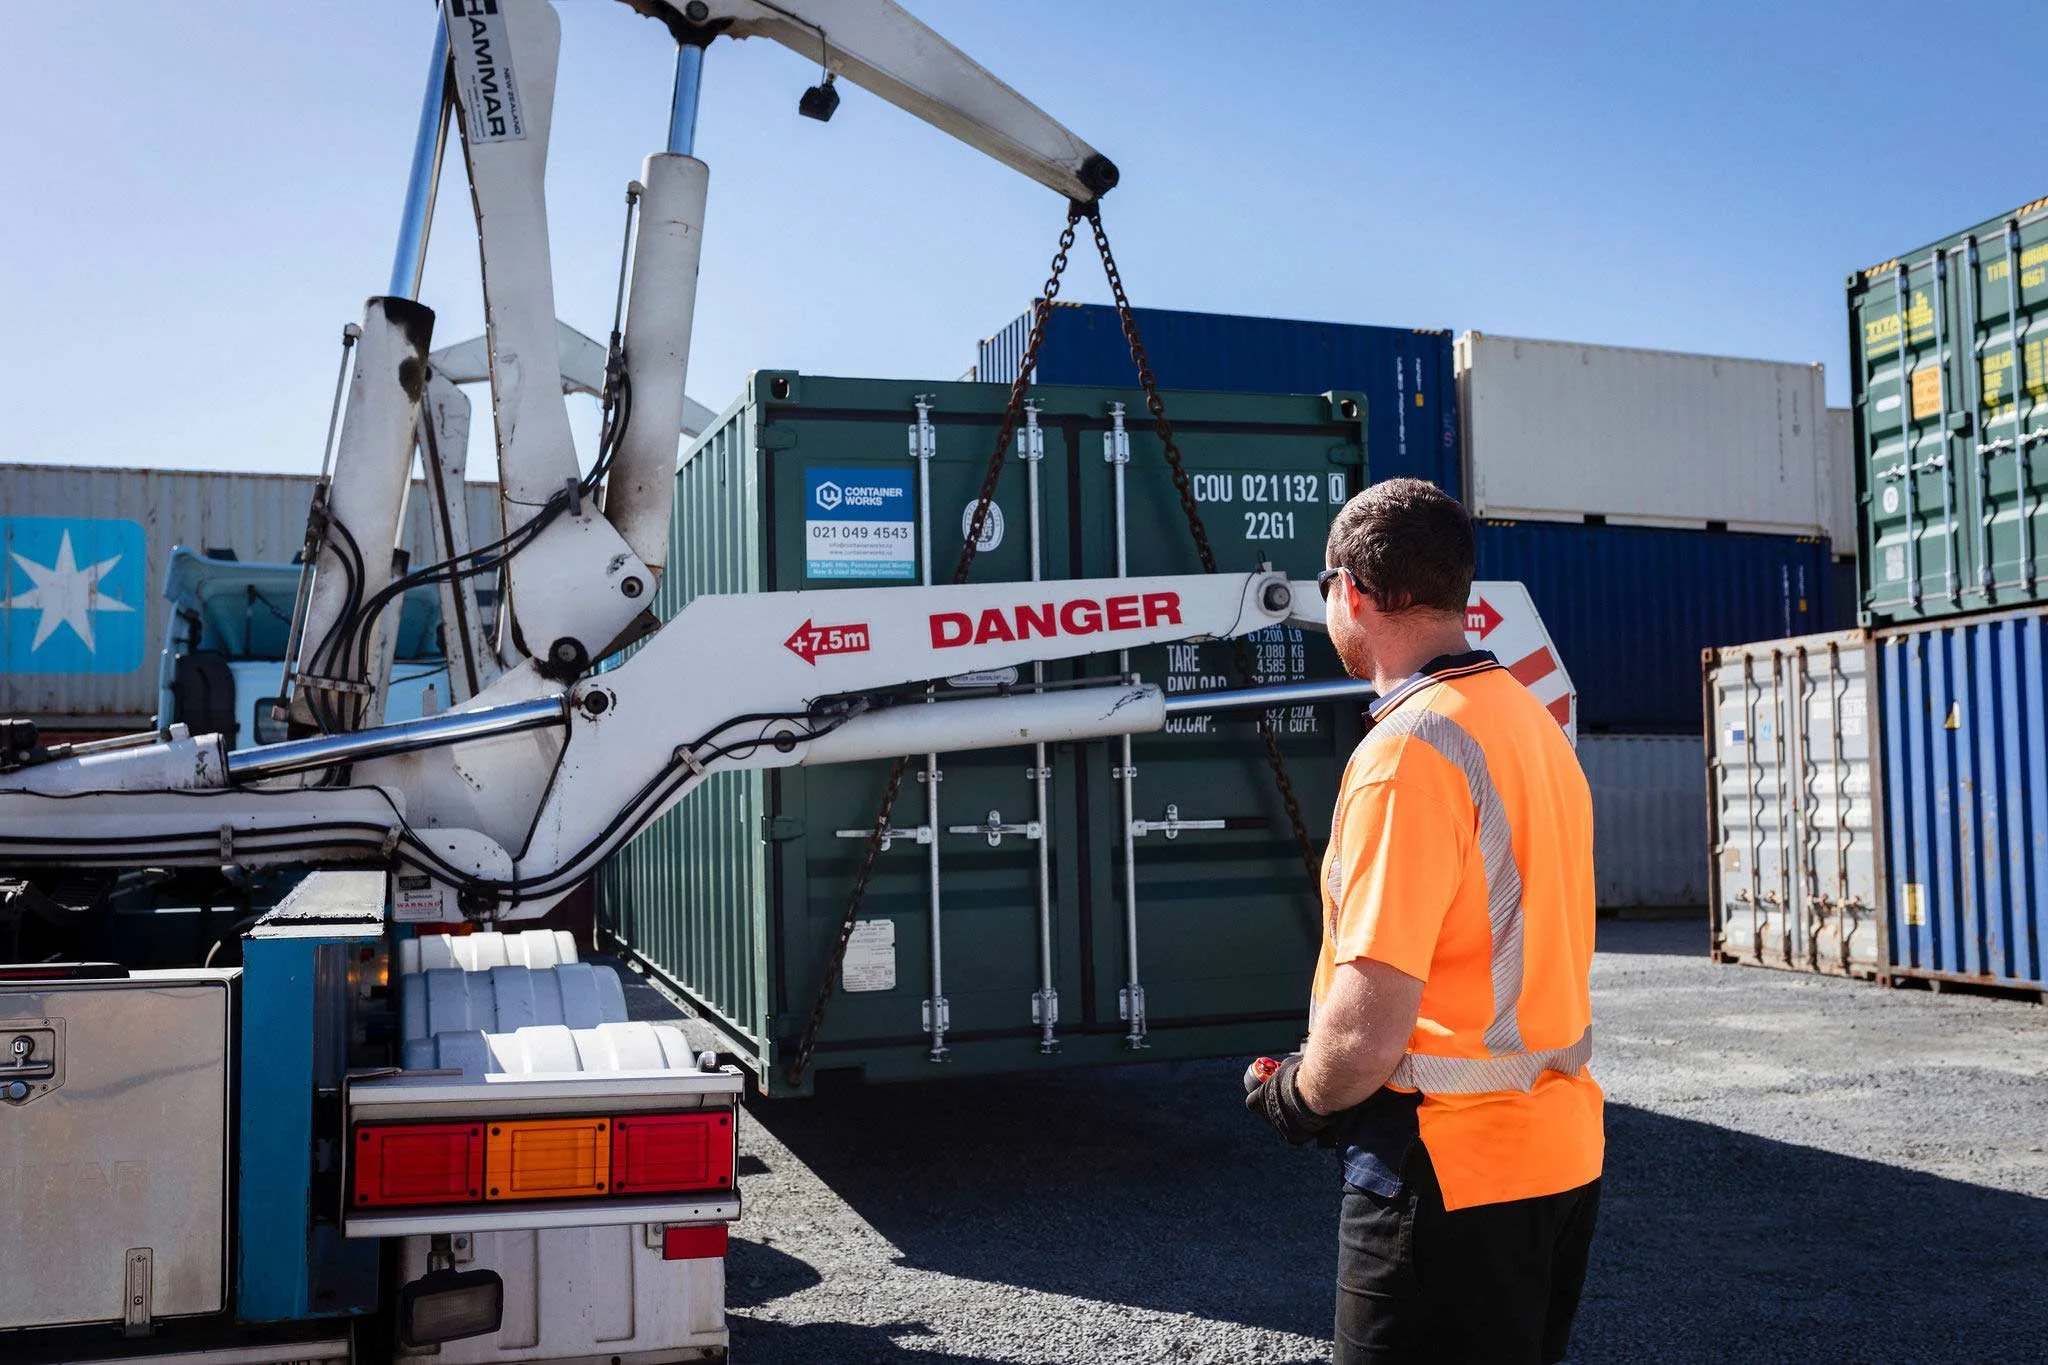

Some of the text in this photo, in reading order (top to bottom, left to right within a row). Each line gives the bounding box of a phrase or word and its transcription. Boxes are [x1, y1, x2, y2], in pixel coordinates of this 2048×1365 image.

[465, 0, 506, 137] HAMMAR
[507, 90, 521, 134] ZEALAND
[844, 487, 903, 497] CONTAINER
[1186, 474, 1344, 503] COU 021132 0
[845, 496, 883, 506] WORKS
[813, 526, 908, 539] 021 049 4543
[1244, 512, 1294, 539] 22G1
[929, 592, 1182, 649] DANGER
[792, 629, 866, 652] +7.5m
[1289, 630, 1303, 643] LB
[1167, 645, 1304, 672] TARE 2.080 KG
[1257, 659, 1305, 673] 4.585 LB
[396, 901, 441, 909] WARNING
